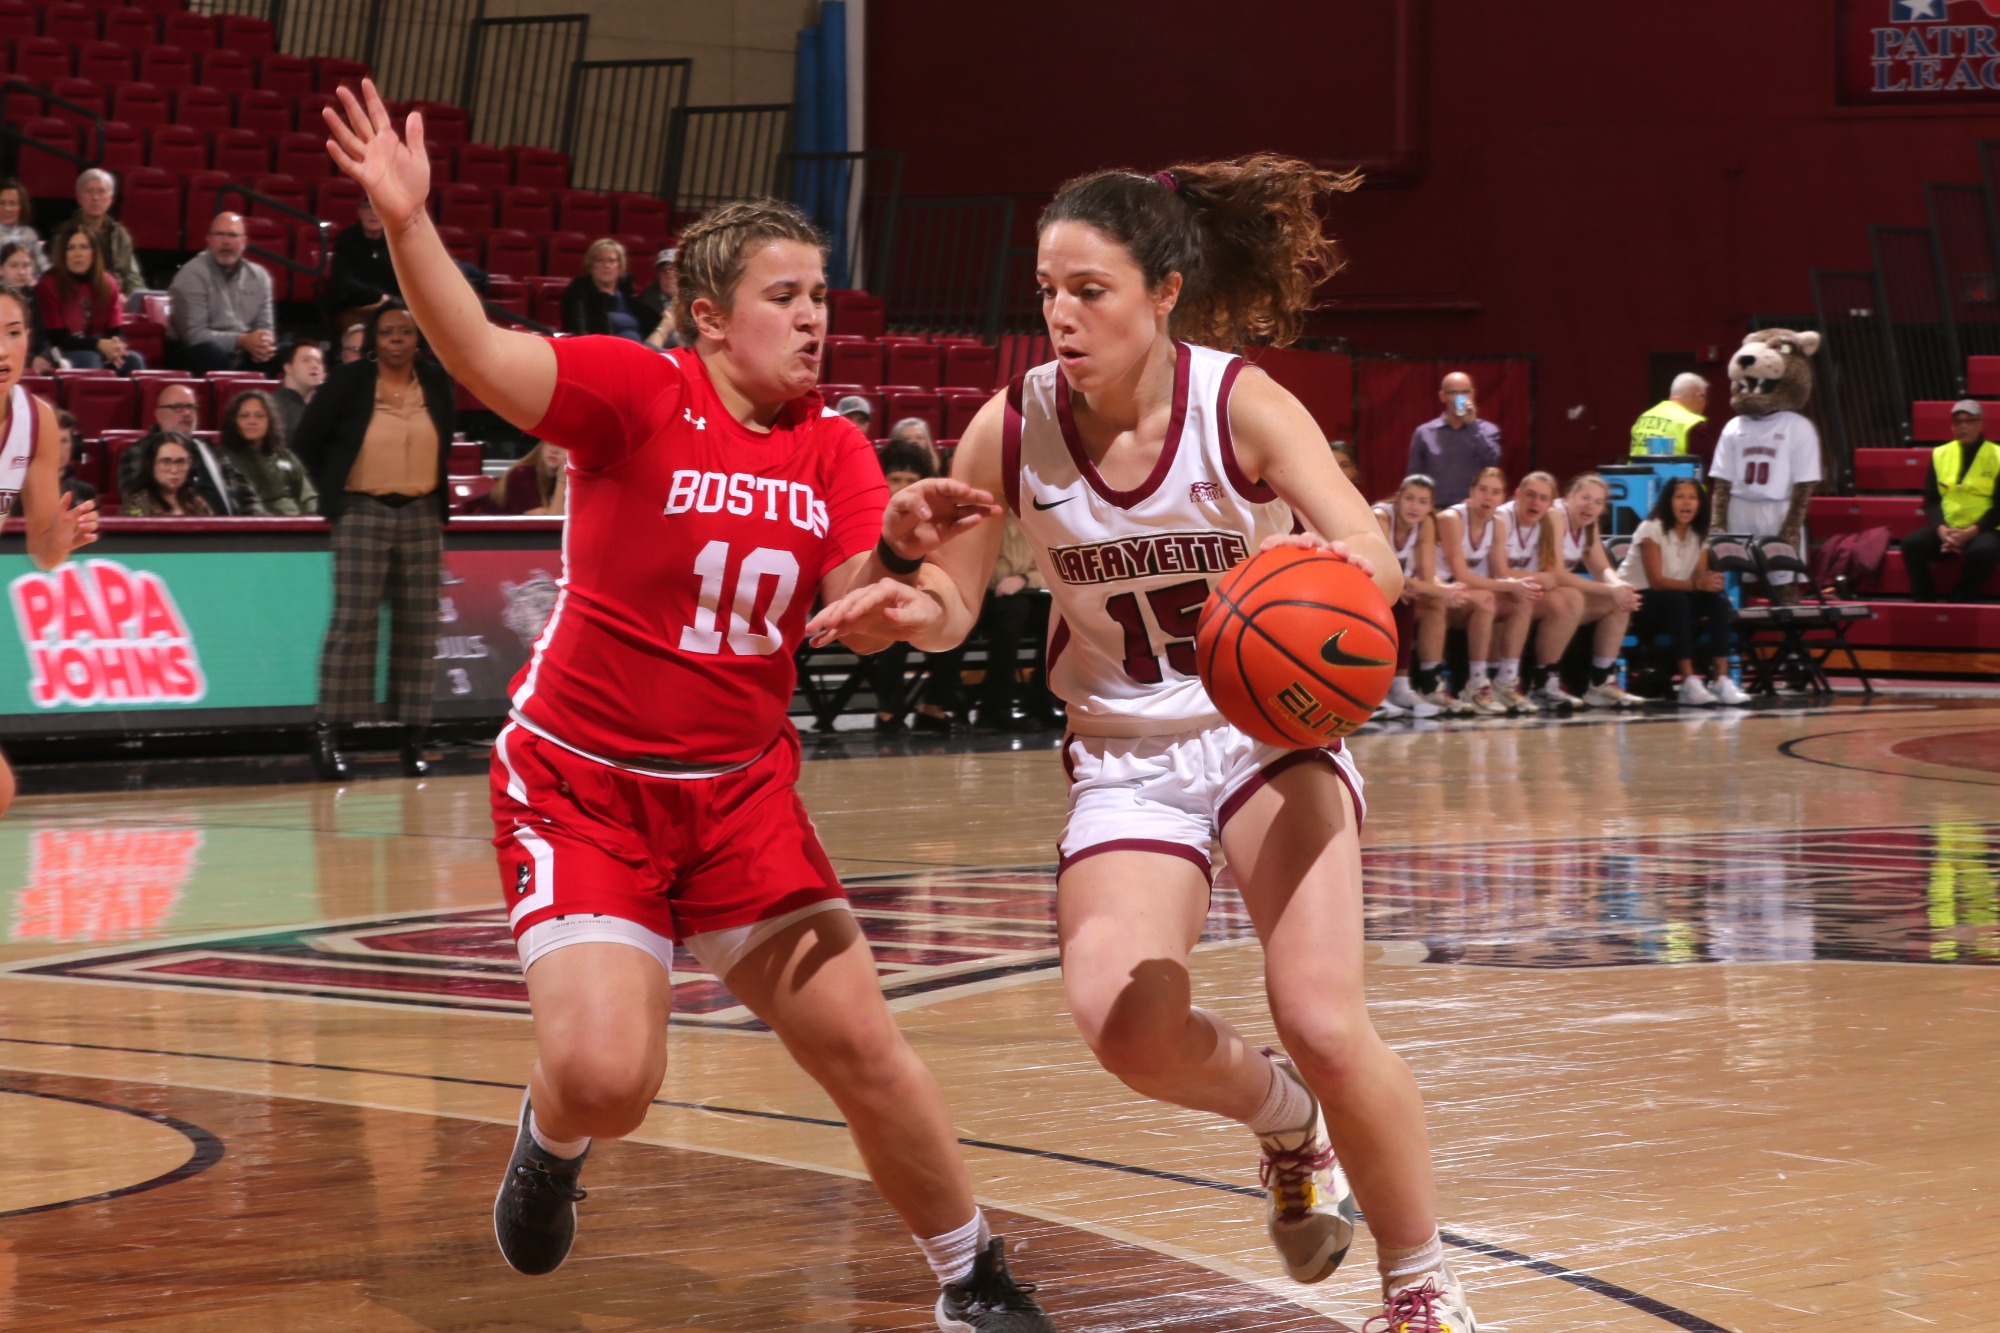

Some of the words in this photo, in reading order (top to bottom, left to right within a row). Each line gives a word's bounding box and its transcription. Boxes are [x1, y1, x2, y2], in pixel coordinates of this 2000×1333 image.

[1870, 25, 2000, 60] PATR
[1744, 461, 1769, 486] 00
[663, 469, 830, 539] BOSTON
[1048, 535, 1249, 583] LAFAYETTE
[12, 561, 190, 643] PAPA
[678, 540, 800, 655] 10
[1105, 578, 1211, 683] 15
[31, 645, 205, 705] JOHNS
[1276, 680, 1359, 738] ELITE
